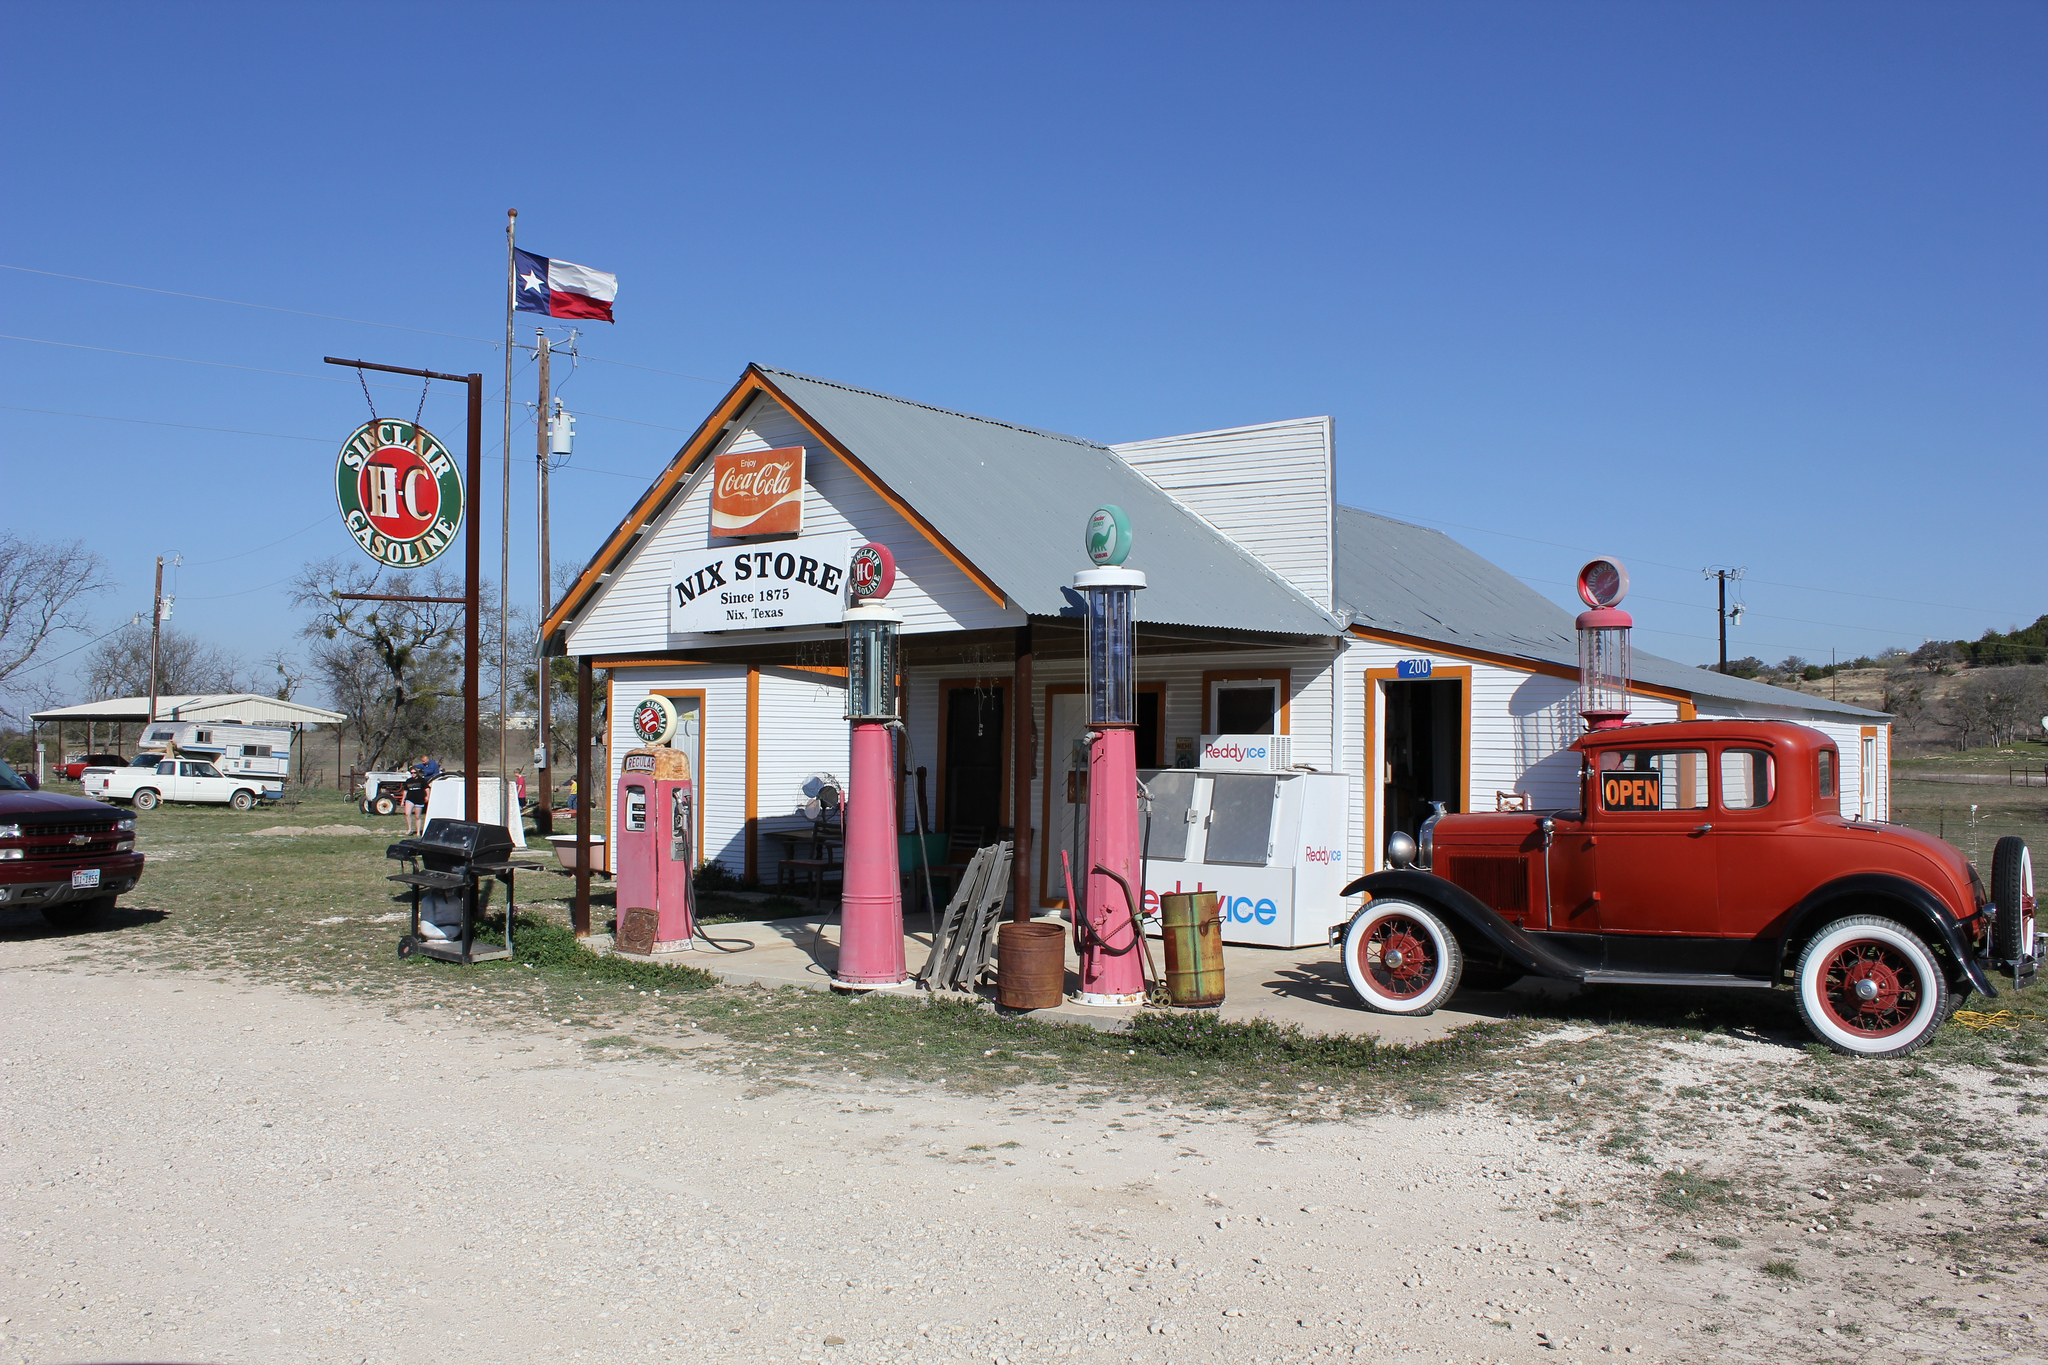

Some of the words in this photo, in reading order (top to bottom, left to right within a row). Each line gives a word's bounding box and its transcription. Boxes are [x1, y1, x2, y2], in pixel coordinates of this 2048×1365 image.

[343, 424, 451, 479] SINCLAIR
[740, 459, 757, 468] Enjoy
[717, 460, 795, 499] Coca-Cola
[347, 509, 456, 563] GASOLINE
[851, 549, 880, 570] SINCLAIR
[674, 560, 727, 608] NIX
[734, 552, 843, 596] STORE
[851, 575, 881, 595] GASOLINE
[720, 591, 755, 605] Since
[759, 587, 790, 602] 1875
[726, 609, 748, 621] Nix,
[751, 608, 784, 619] Texas
[1408, 659, 1428, 674] 200
[634, 707, 655, 741] GASOLINE
[645, 701, 667, 734] SINCLAIR
[628, 757, 655, 769] REGULAR
[1605, 779, 1659, 806] OPEN
